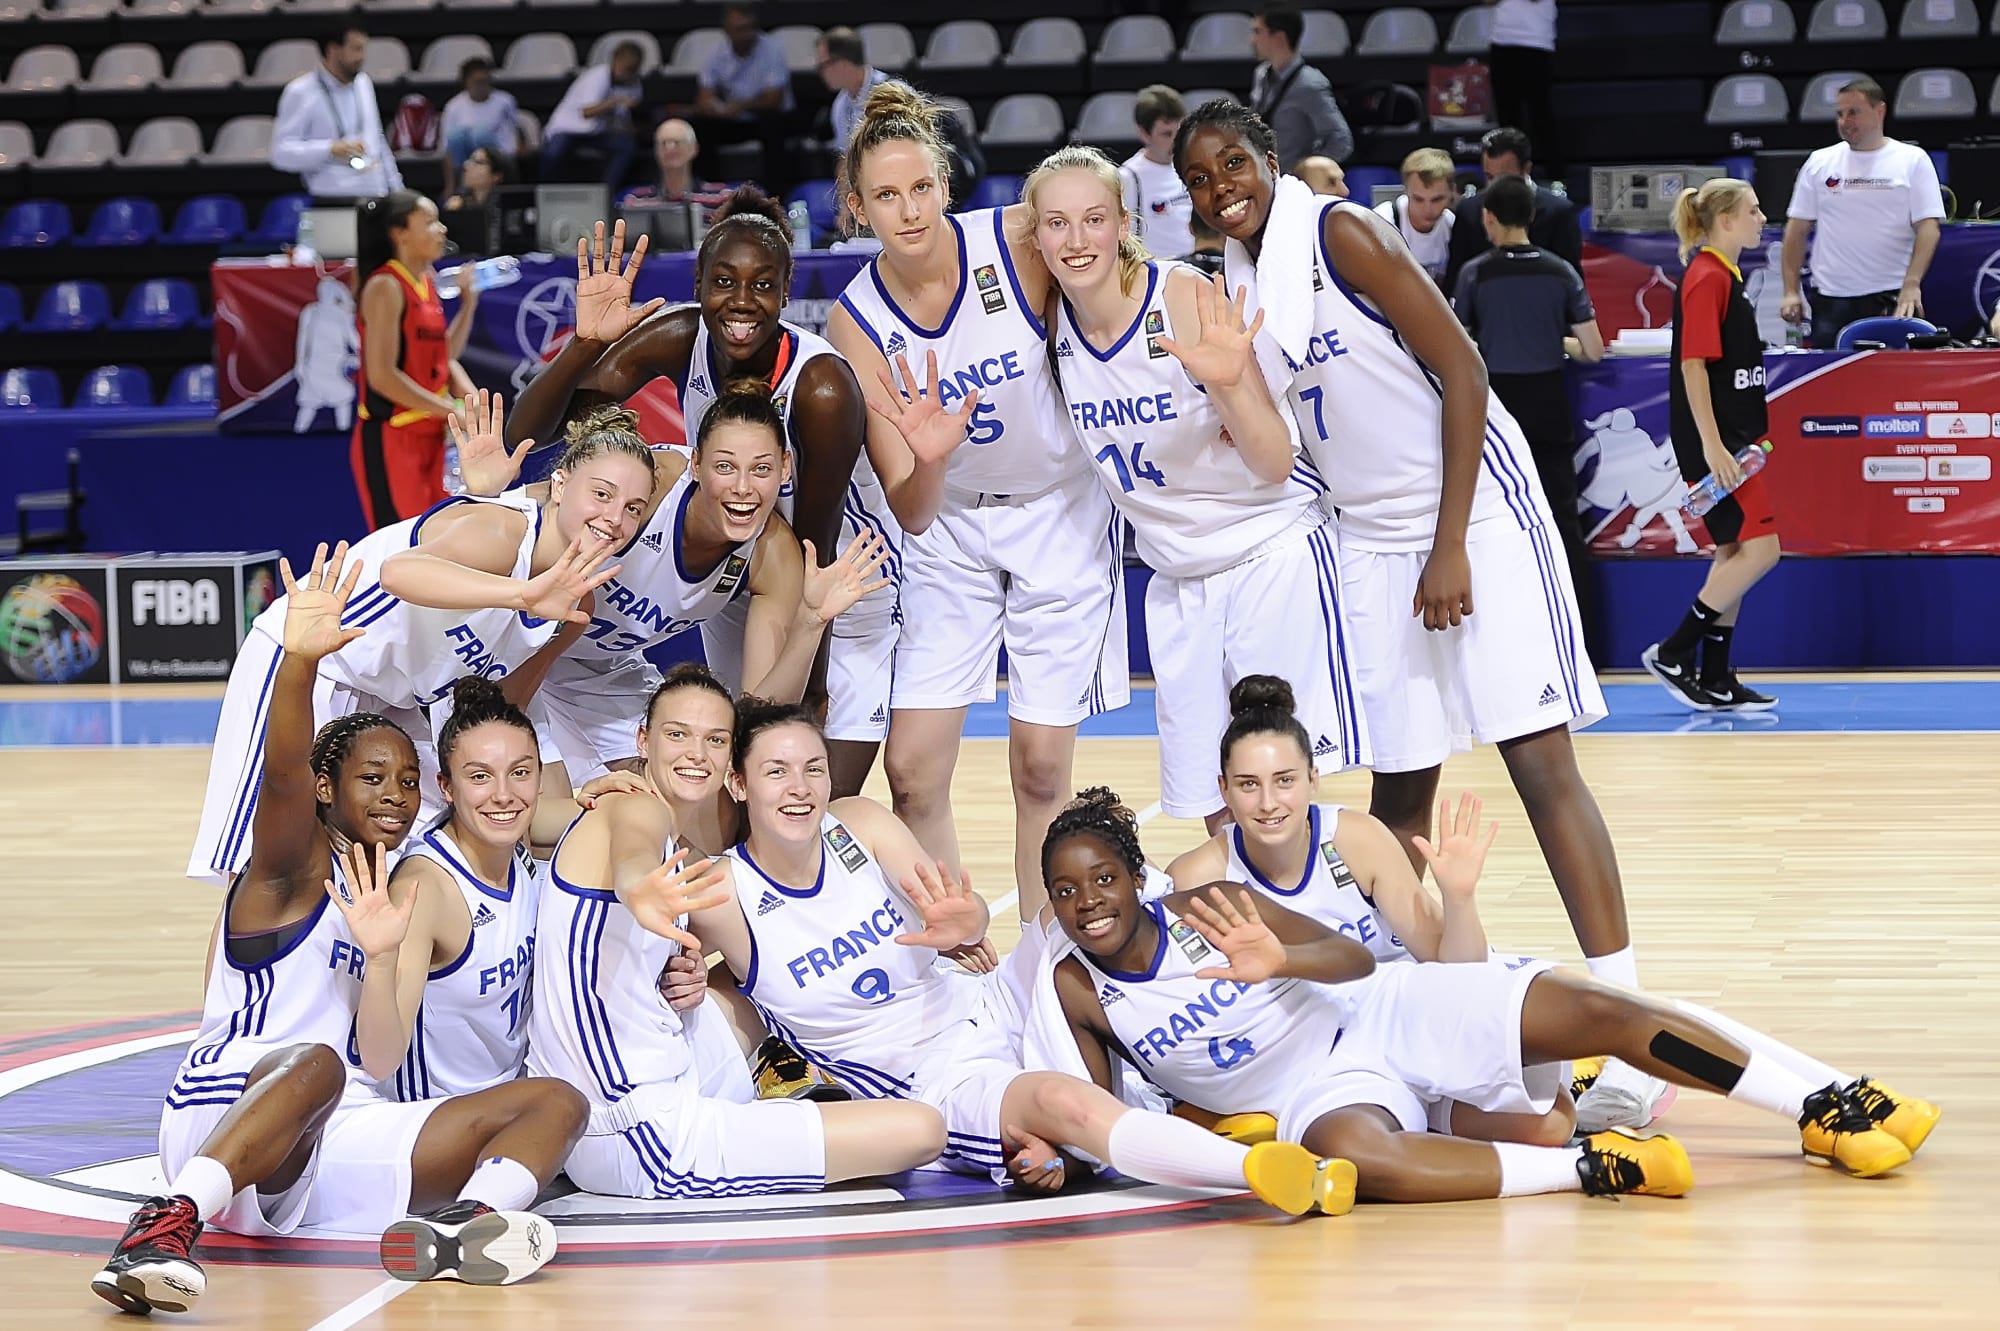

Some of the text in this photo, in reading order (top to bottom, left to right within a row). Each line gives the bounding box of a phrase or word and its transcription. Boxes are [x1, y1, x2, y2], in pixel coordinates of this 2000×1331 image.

[964, 403, 1005, 445] 5
[1071, 392, 1178, 431] FRANCE
[1298, 385, 1330, 442] 7
[1802, 421, 1860, 435] Champion
[1868, 418, 1921, 433] molten
[1095, 441, 1168, 494] 14
[639, 537, 662, 554] adidas
[132, 578, 220, 626] FIBA
[1538, 692, 1562, 707] adidas
[1312, 744, 1339, 757] adidas
[471, 913, 496, 929] adidas
[757, 897, 786, 917] adidas
[786, 898, 904, 989] FRANCE
[851, 967, 897, 1006] 9
[1208, 1036, 1257, 1070] 4
